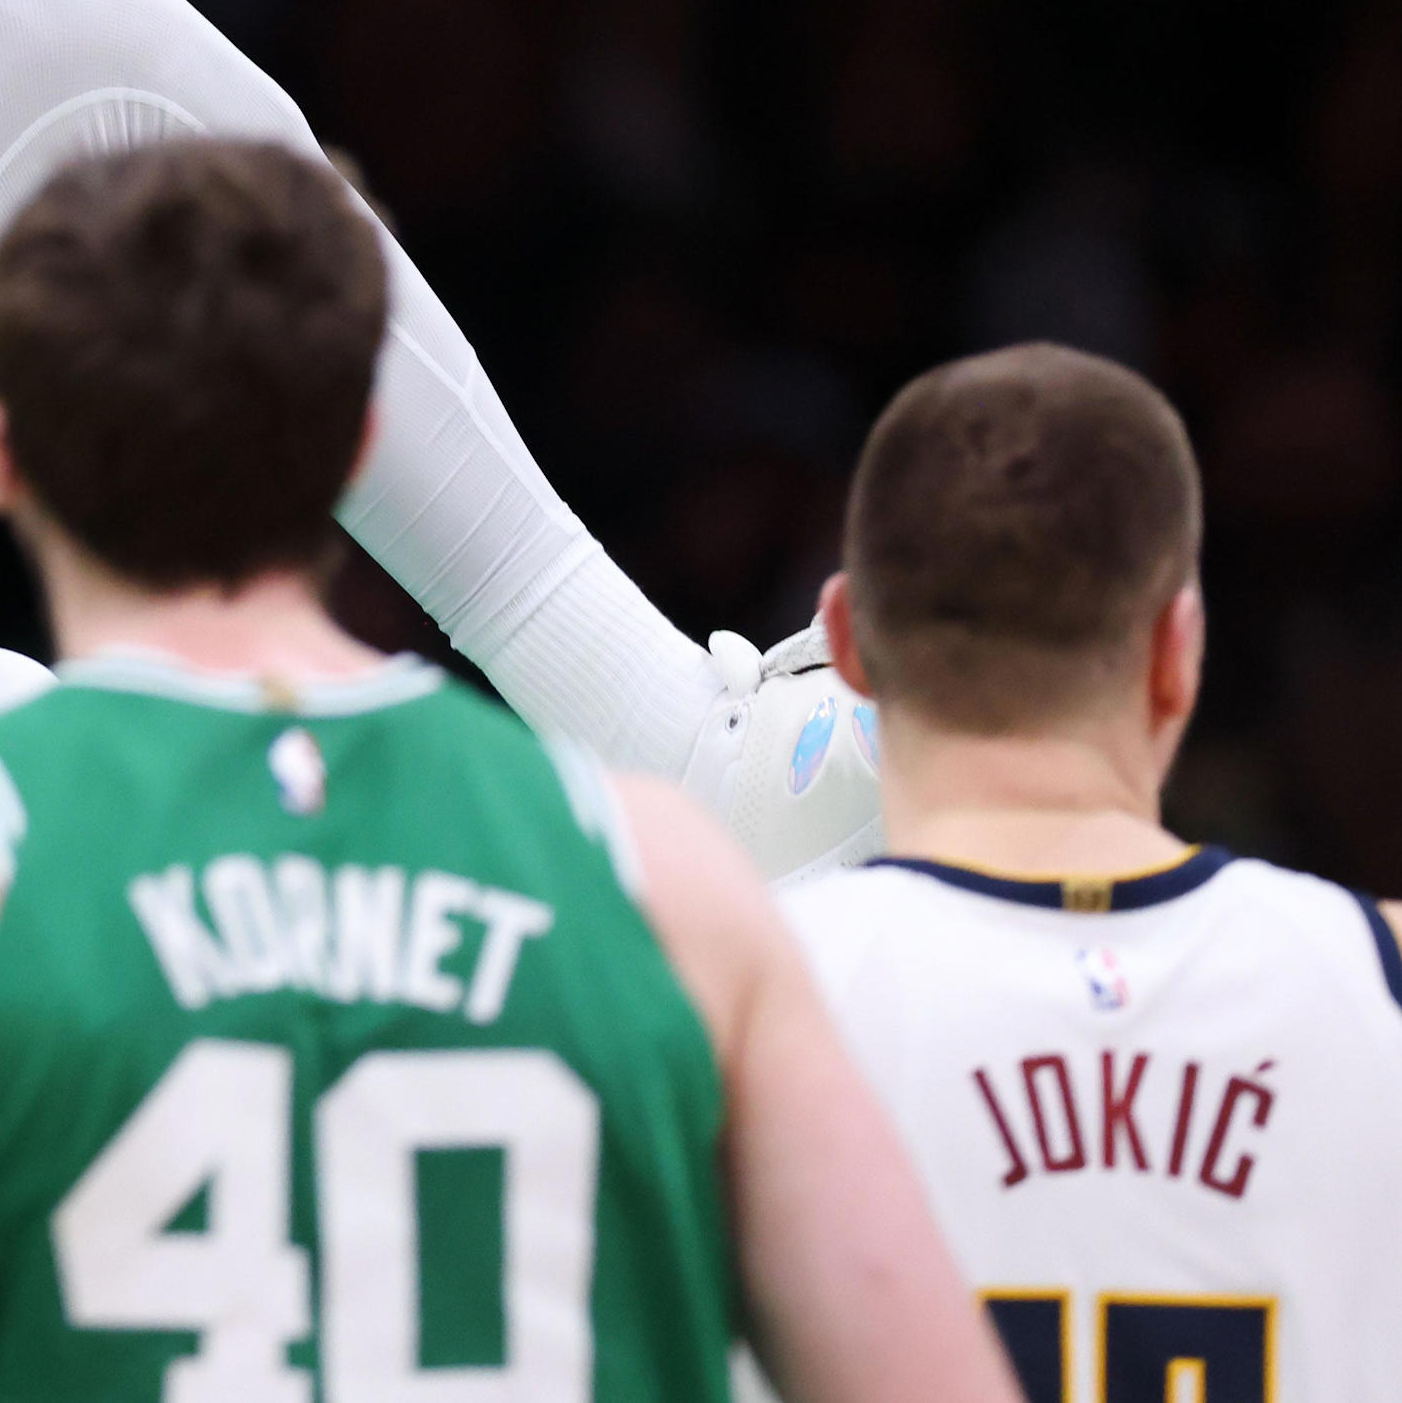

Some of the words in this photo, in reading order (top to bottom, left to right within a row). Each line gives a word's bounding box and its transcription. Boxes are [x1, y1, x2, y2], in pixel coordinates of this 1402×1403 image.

[127, 851, 555, 1025] KORNET
[972, 1047, 1278, 1200] JOKIĆ
[50, 1035, 601, 1403] 40
